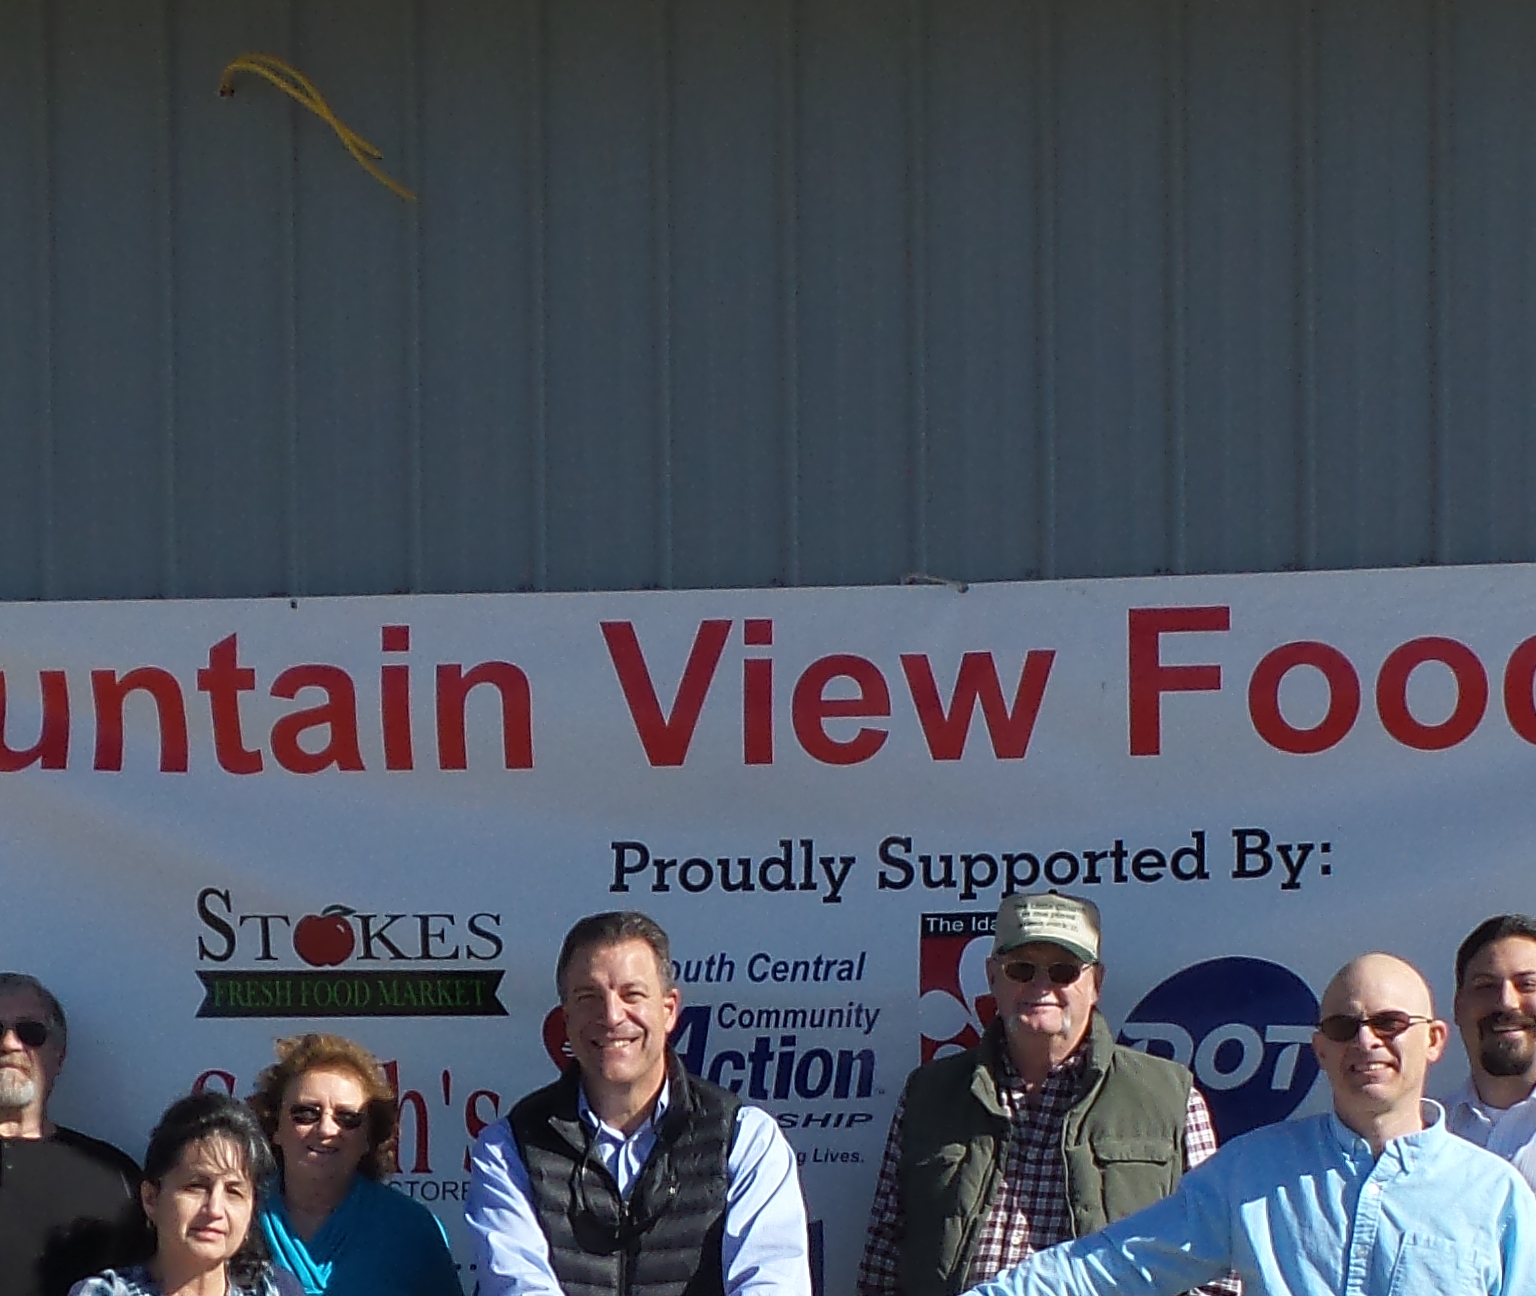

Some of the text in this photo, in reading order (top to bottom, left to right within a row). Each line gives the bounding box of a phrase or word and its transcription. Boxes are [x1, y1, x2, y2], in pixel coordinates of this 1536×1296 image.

[599, 618, 1056, 768] View
[609, 827, 1332, 903] Proudly Supported By:
[926, 916, 997, 932] The Ida
[671, 951, 867, 983] outh Central
[215, 980, 486, 1007] FRESH FOOD MARKET
[718, 1002, 881, 1035] Community
[777, 1112, 873, 1128] SHIP
[813, 1147, 865, 1163] Lives.
